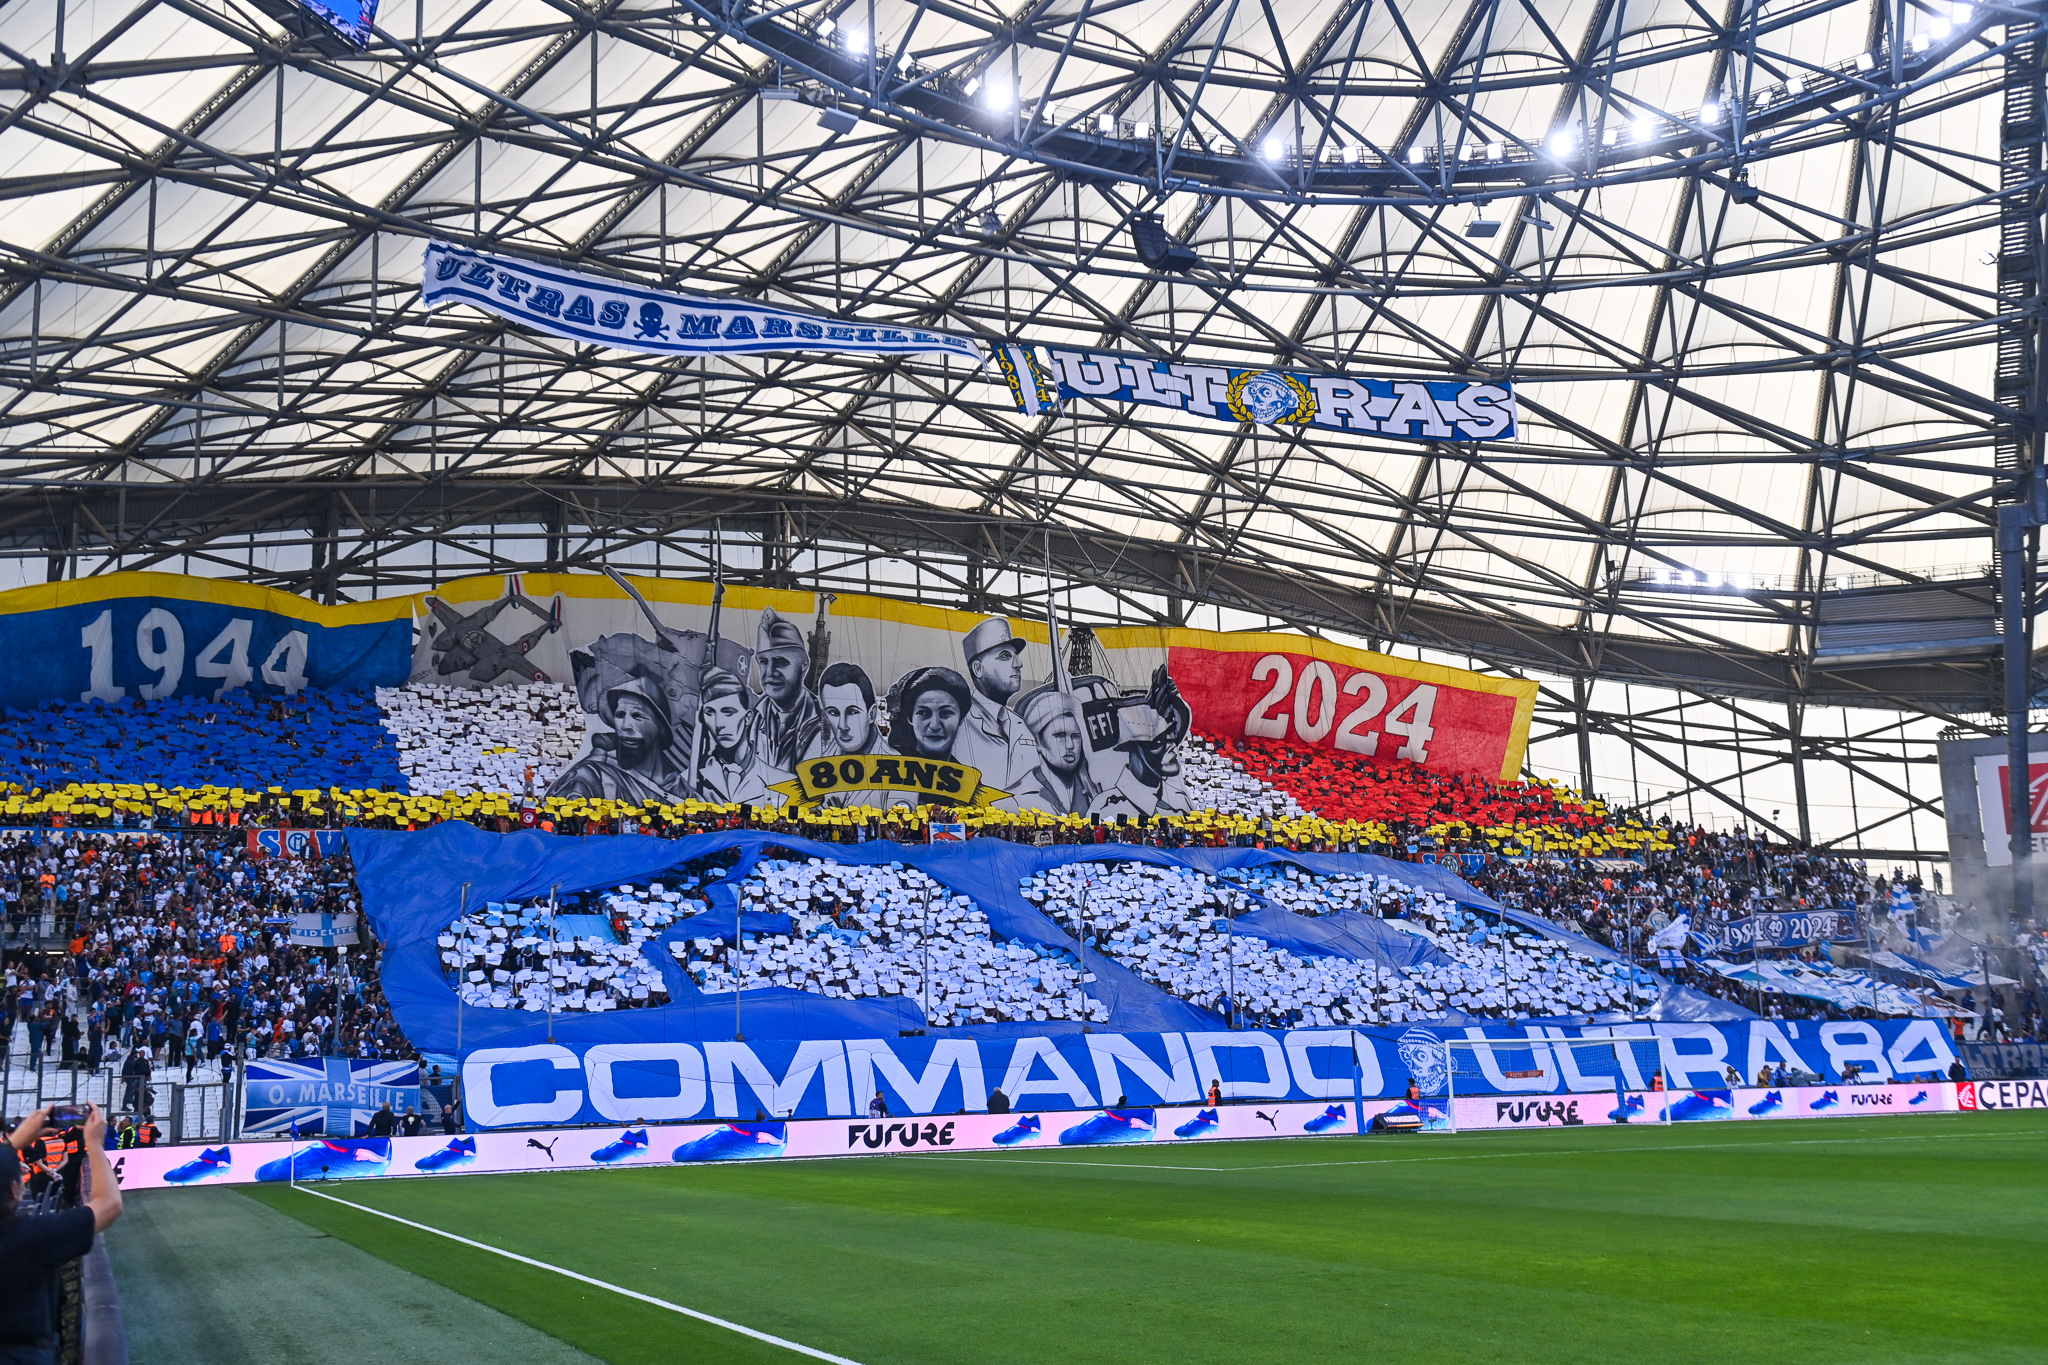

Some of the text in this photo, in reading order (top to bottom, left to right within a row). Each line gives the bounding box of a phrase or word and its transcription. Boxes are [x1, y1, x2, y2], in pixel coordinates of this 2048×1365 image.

[436, 256, 968, 348] ULTRAS MARSEILLE
[1022, 350, 1050, 402] 2024
[81, 607, 309, 702] 1944
[1244, 654, 1438, 763] 2024
[1087, 711, 1114, 740] FFI
[810, 759, 964, 793] 80 ANS
[296, 926, 355, 937] FIDELITE
[1723, 919, 1763, 947] 1984
[1790, 916, 1833, 939] 2024
[1958, 1043, 2048, 1068] LTRA
[463, 1030, 1383, 1128] COMMANDO
[268, 1082, 405, 1110] O. MARSEILLE
[1851, 1093, 1893, 1105] FUTURE
[1979, 1081, 2048, 1110] CEPA
[1497, 1100, 1578, 1124] FUTURE
[849, 1122, 955, 1148] FUTURE
